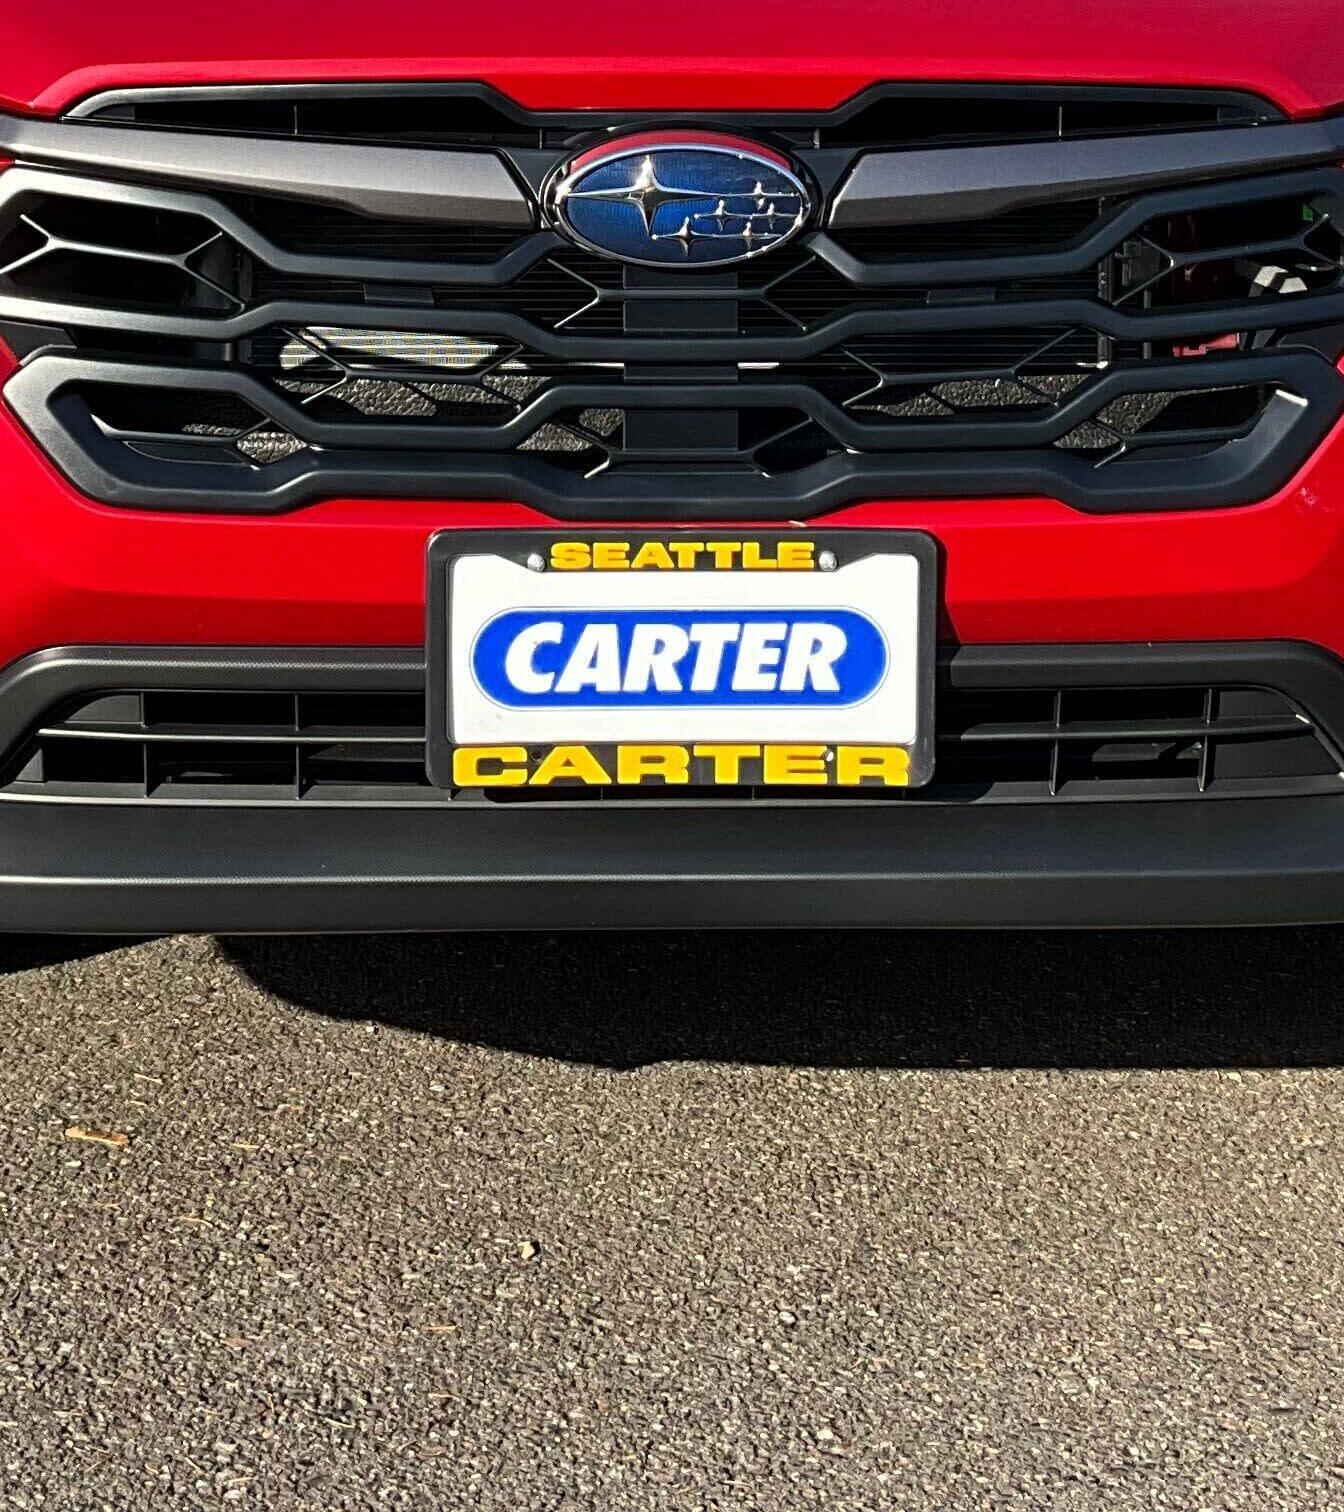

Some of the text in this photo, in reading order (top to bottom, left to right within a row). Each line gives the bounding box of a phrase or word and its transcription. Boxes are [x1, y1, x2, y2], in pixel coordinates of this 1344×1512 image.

[550, 542, 815, 570] SEATTLE
[505, 621, 848, 694] CARTER
[453, 745, 910, 786] CARTER
